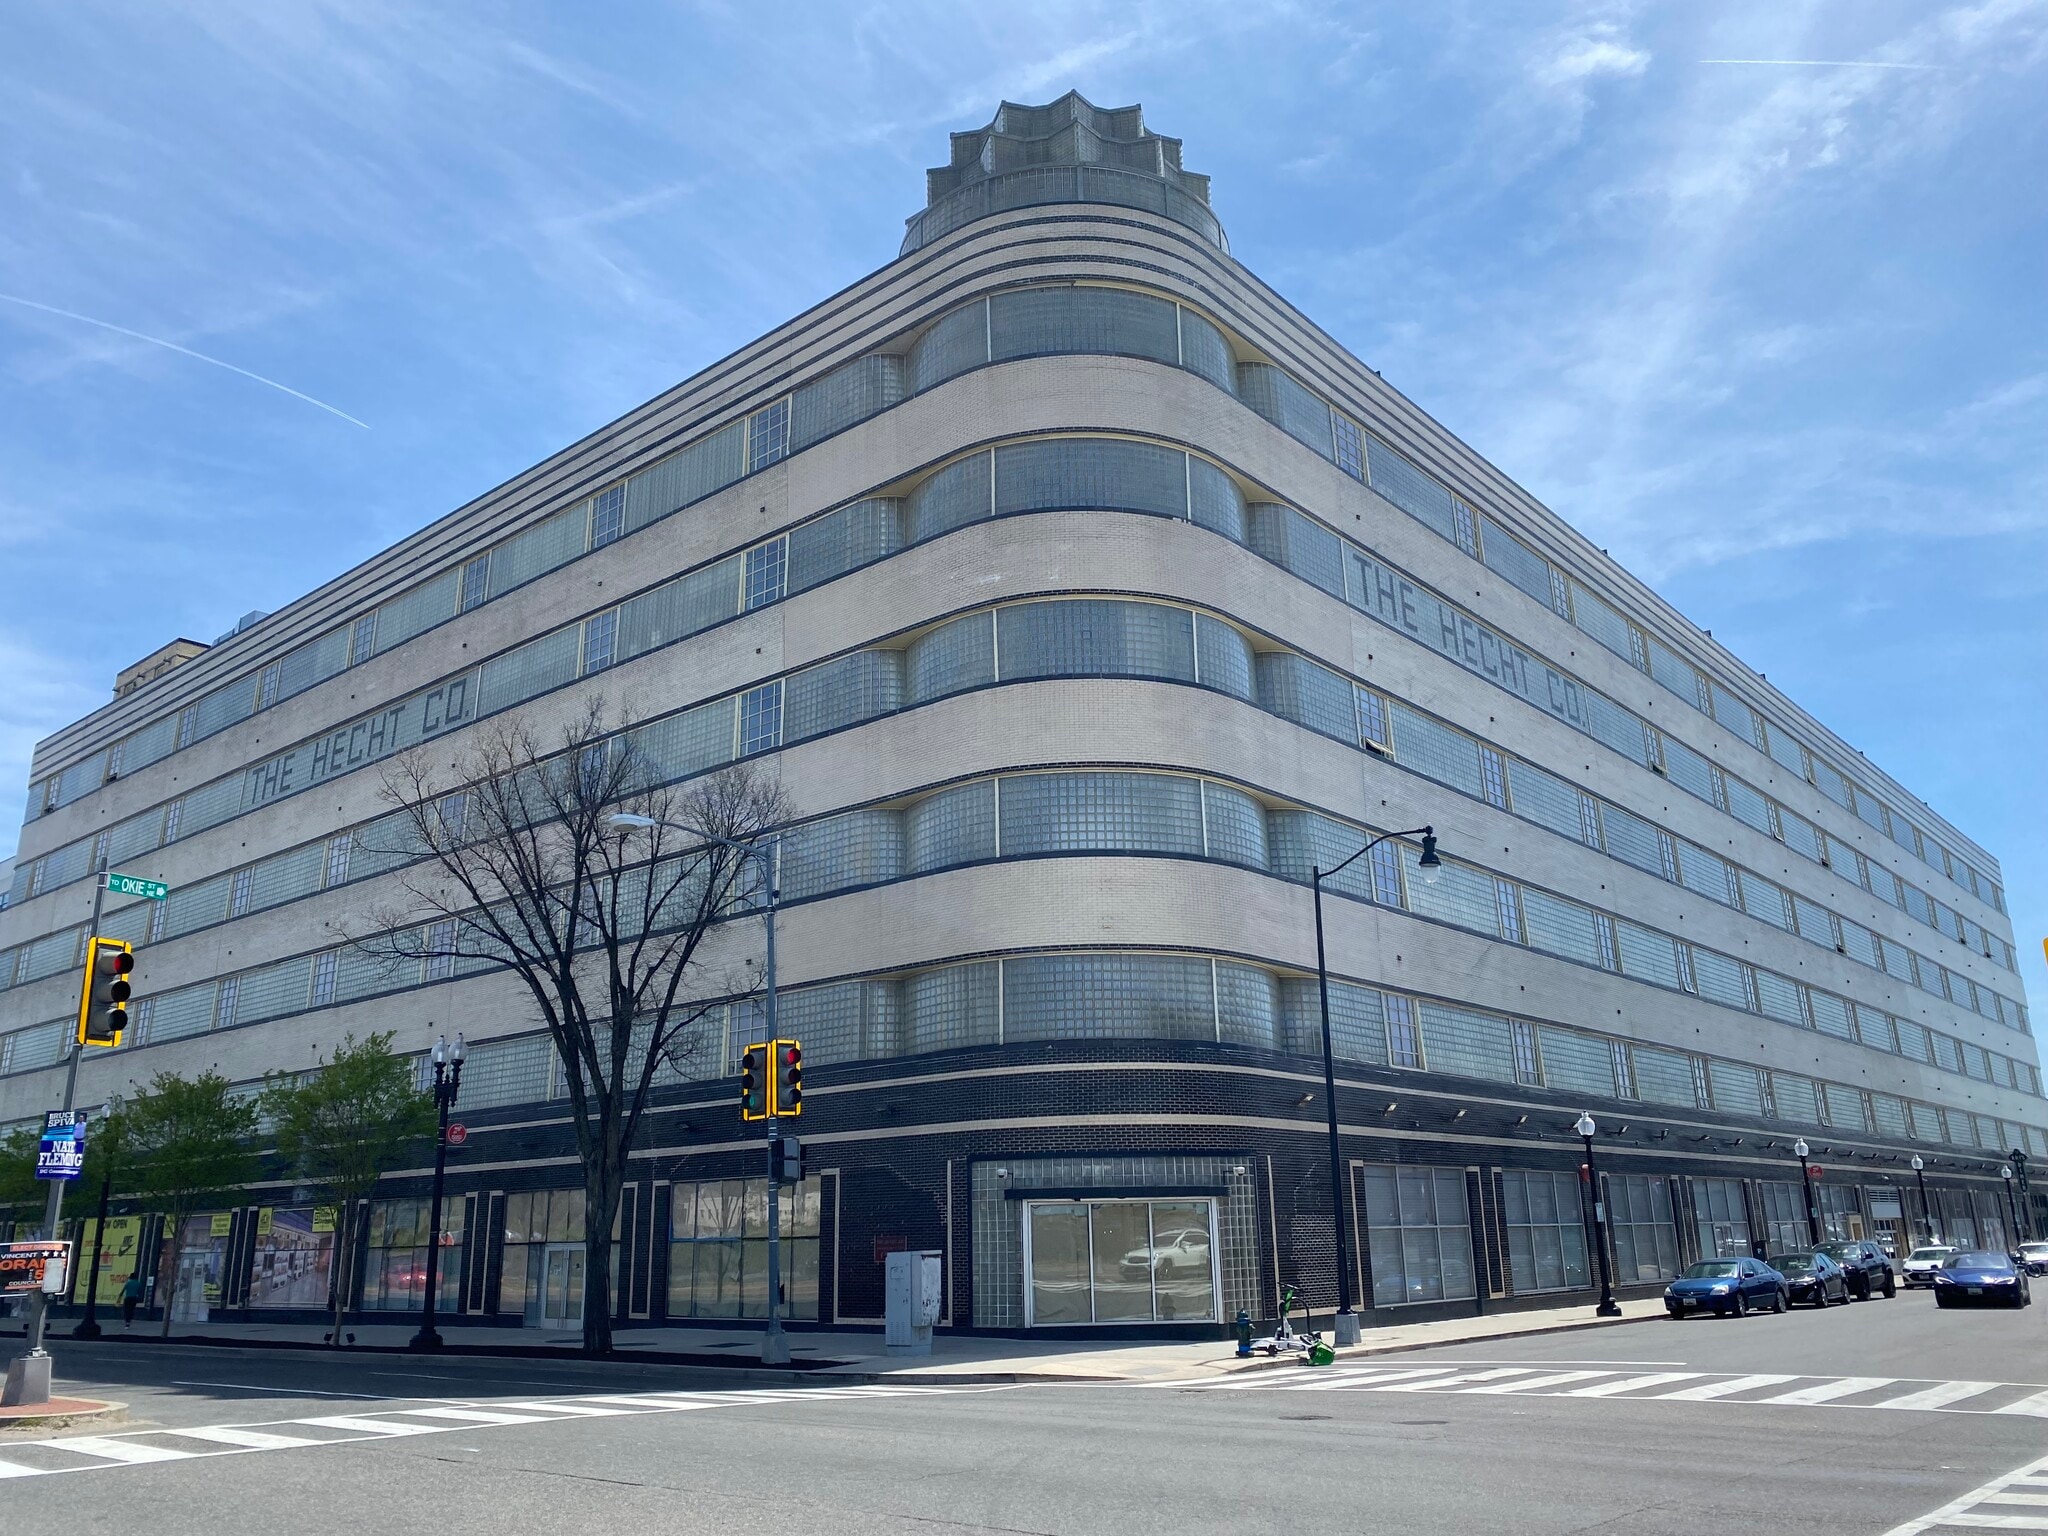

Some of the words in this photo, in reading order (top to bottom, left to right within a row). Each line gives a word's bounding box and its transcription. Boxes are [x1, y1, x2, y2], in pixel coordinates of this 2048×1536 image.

[1353, 552, 1418, 633] THE
[1438, 603, 1528, 695] HECHT
[1545, 668, 1586, 727] CO.
[252, 753, 296, 804] THE
[310, 705, 405, 780] HECHT
[422, 678, 469, 734] CO.
[121, 878, 145, 895] OKIE
[48, 1118, 75, 1127] SPIVA
[49, 1112, 75, 1120] BRUCE
[38, 1152, 83, 1167] FLEMING
